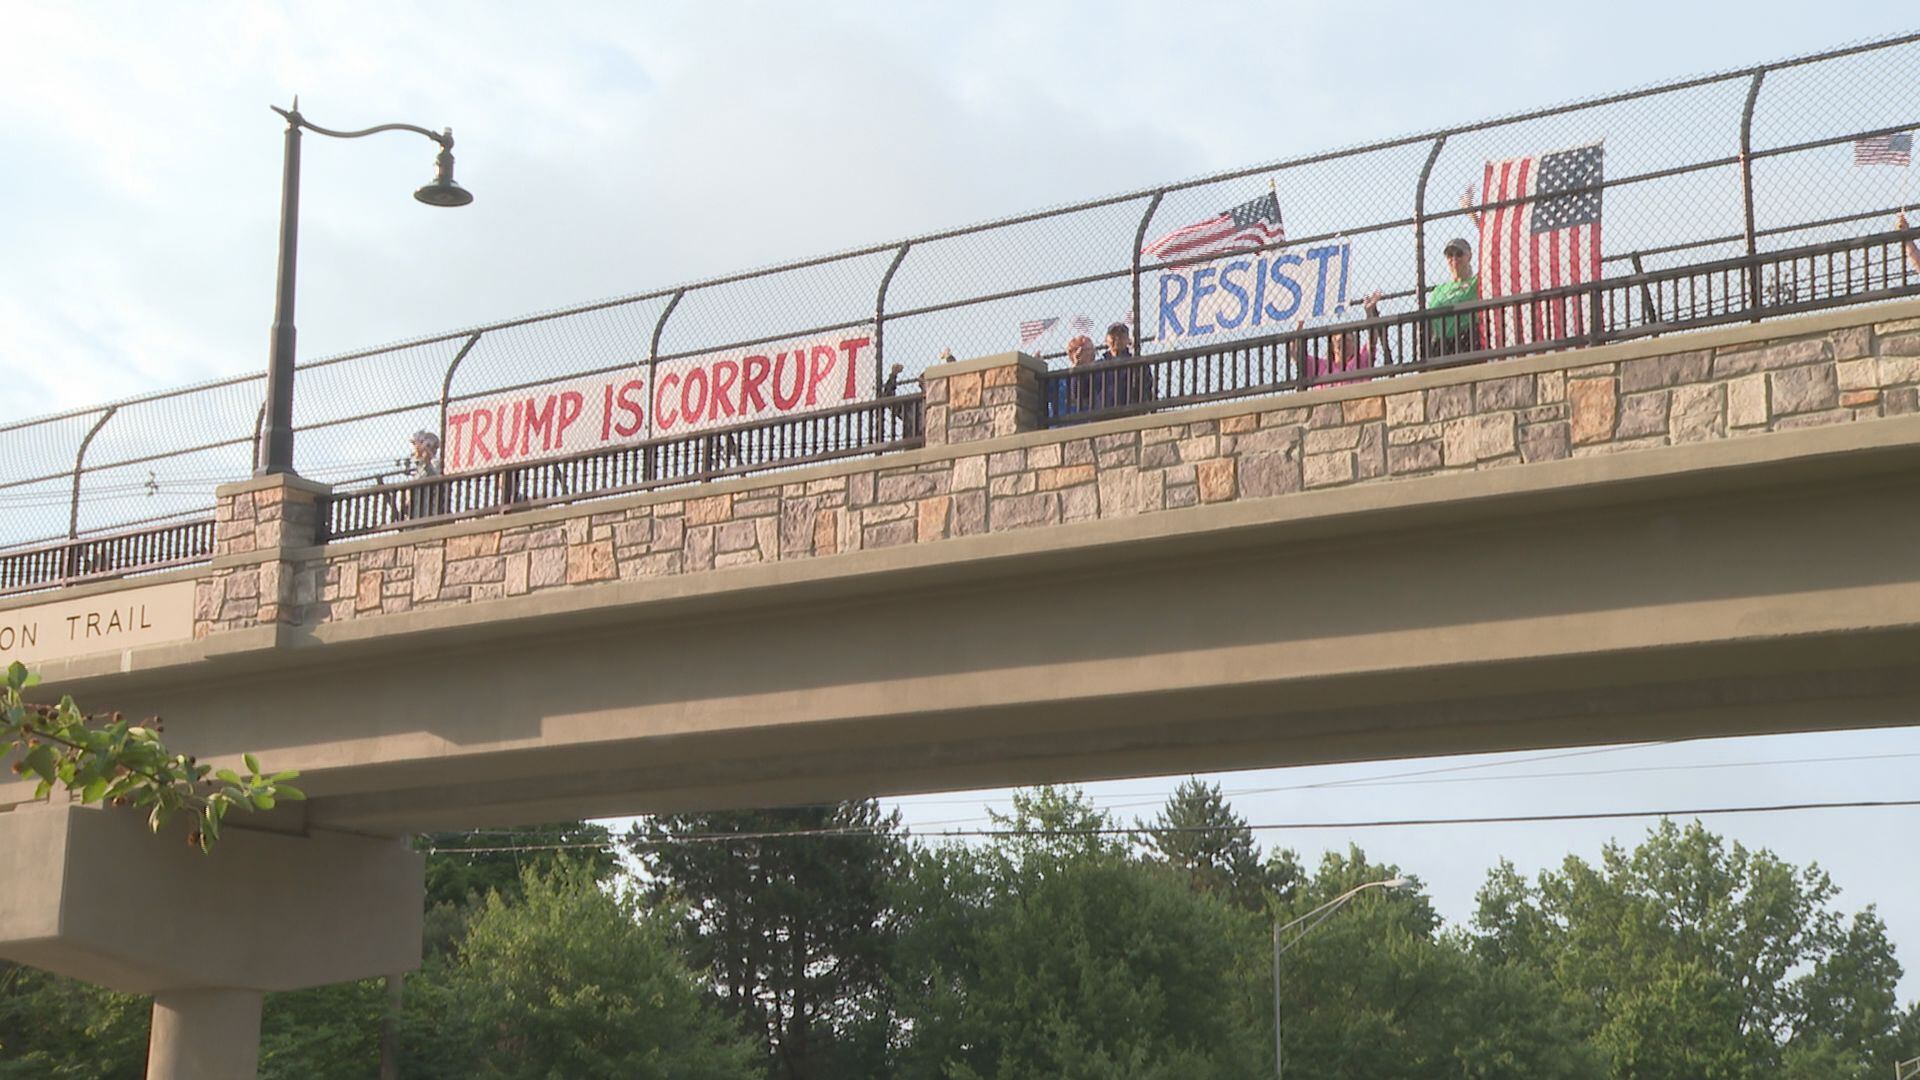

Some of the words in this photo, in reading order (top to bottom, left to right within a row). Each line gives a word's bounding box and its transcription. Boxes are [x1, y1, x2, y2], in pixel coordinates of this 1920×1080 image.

[1158, 243, 1351, 341] RESIST!
[448, 390, 583, 469] TRUMP
[600, 379, 644, 441] IS
[654, 337, 870, 430] CORRUPT
[0, 622, 38, 651] ON
[66, 604, 152, 641] TRAIL
